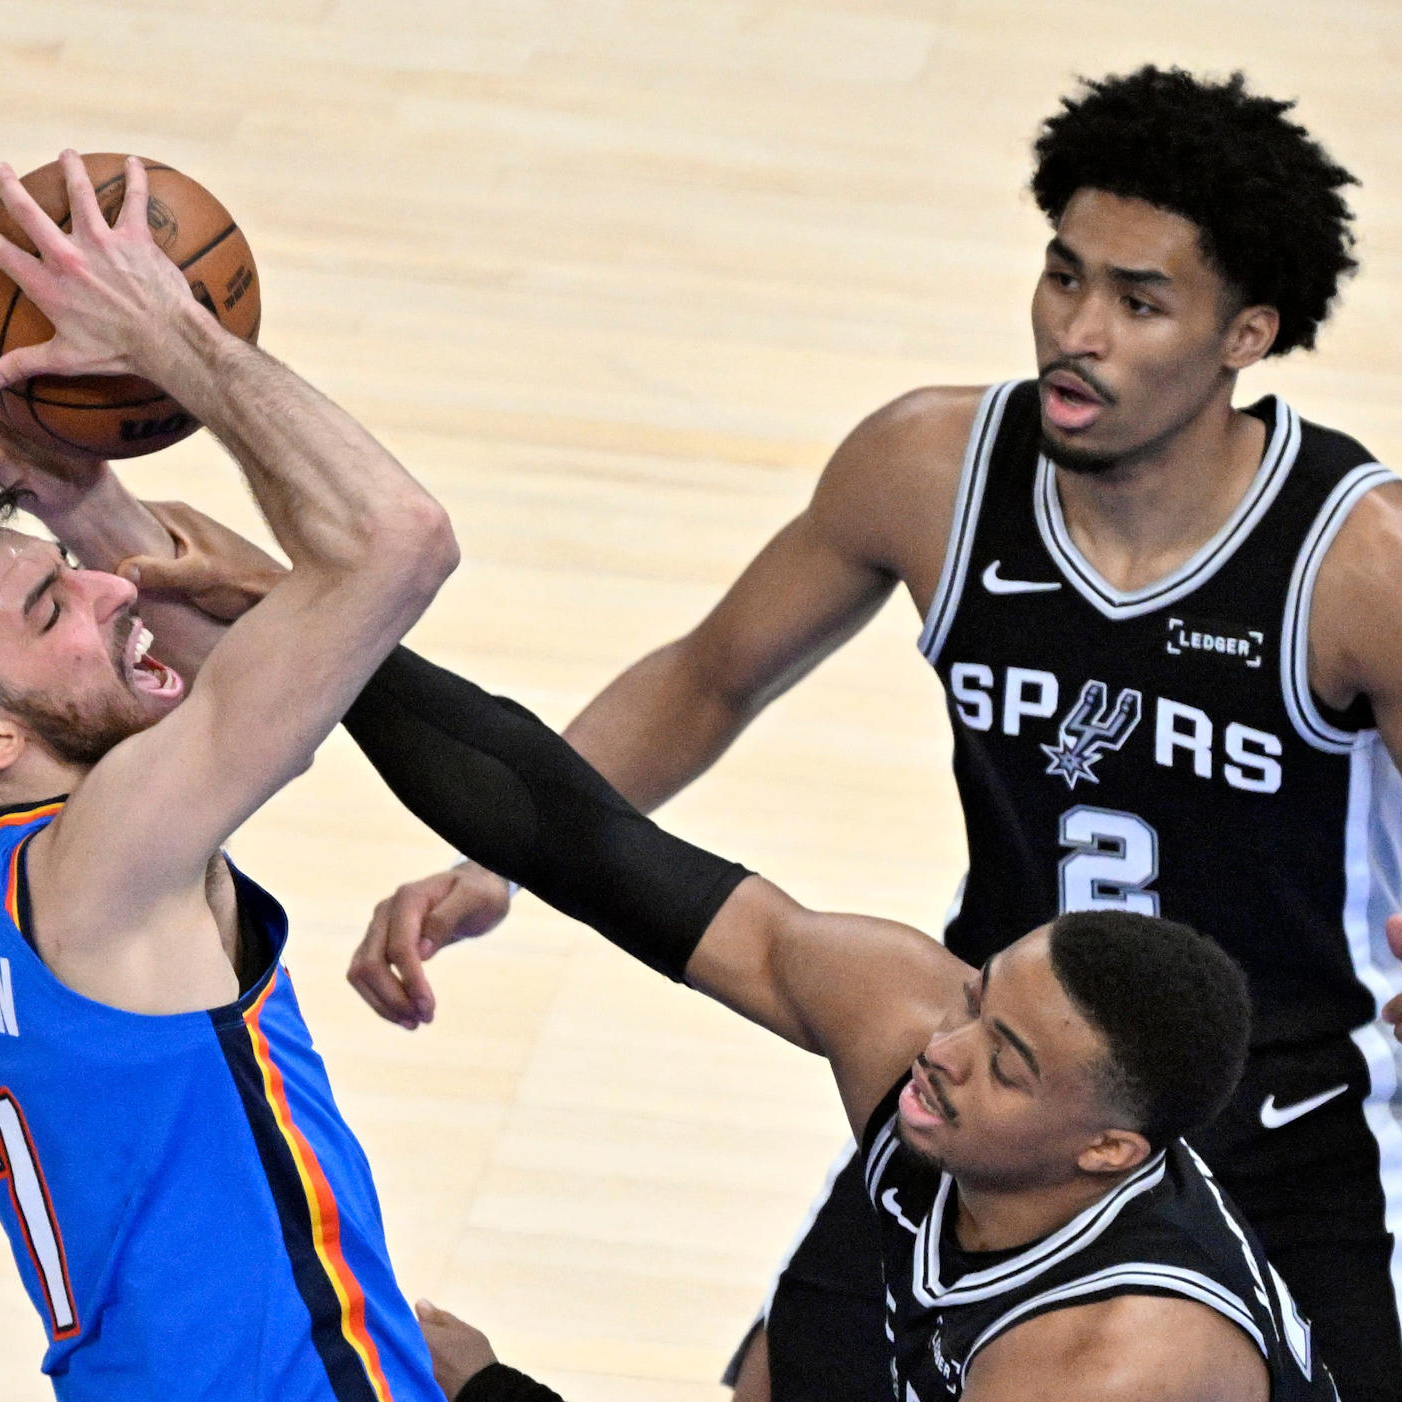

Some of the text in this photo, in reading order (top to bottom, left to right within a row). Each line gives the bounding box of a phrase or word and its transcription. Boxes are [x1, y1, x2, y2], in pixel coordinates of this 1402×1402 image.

[1179, 629, 1250, 657] LEDGER
[950, 662, 1283, 795] SPURS
[1058, 804, 1160, 917] 2
